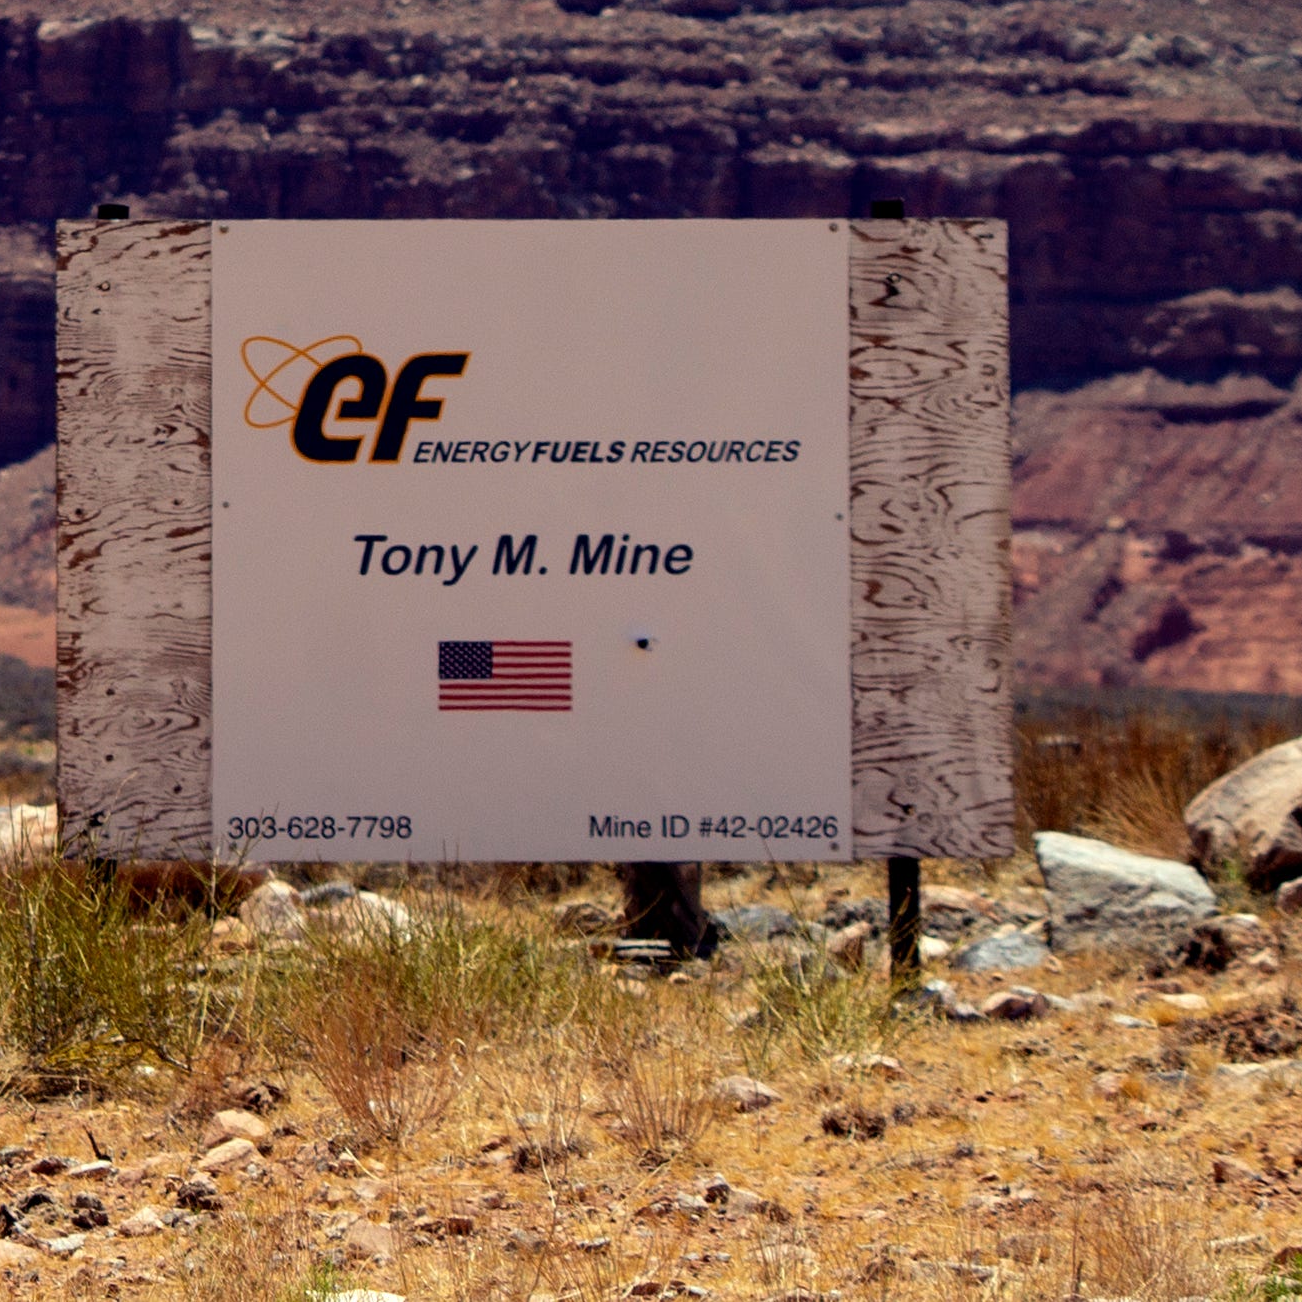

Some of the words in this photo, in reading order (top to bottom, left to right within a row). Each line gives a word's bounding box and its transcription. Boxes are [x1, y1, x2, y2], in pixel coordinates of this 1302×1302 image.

[630, 440, 801, 464] RESOURCES
[353, 534, 478, 586] Tony
[492, 534, 548, 575] M.
[569, 534, 694, 575] Mine
[227, 816, 413, 840] 303-628-7798
[589, 816, 652, 838] Mine
[662, 816, 690, 838] ID
[698, 816, 839, 840] #42-02426
